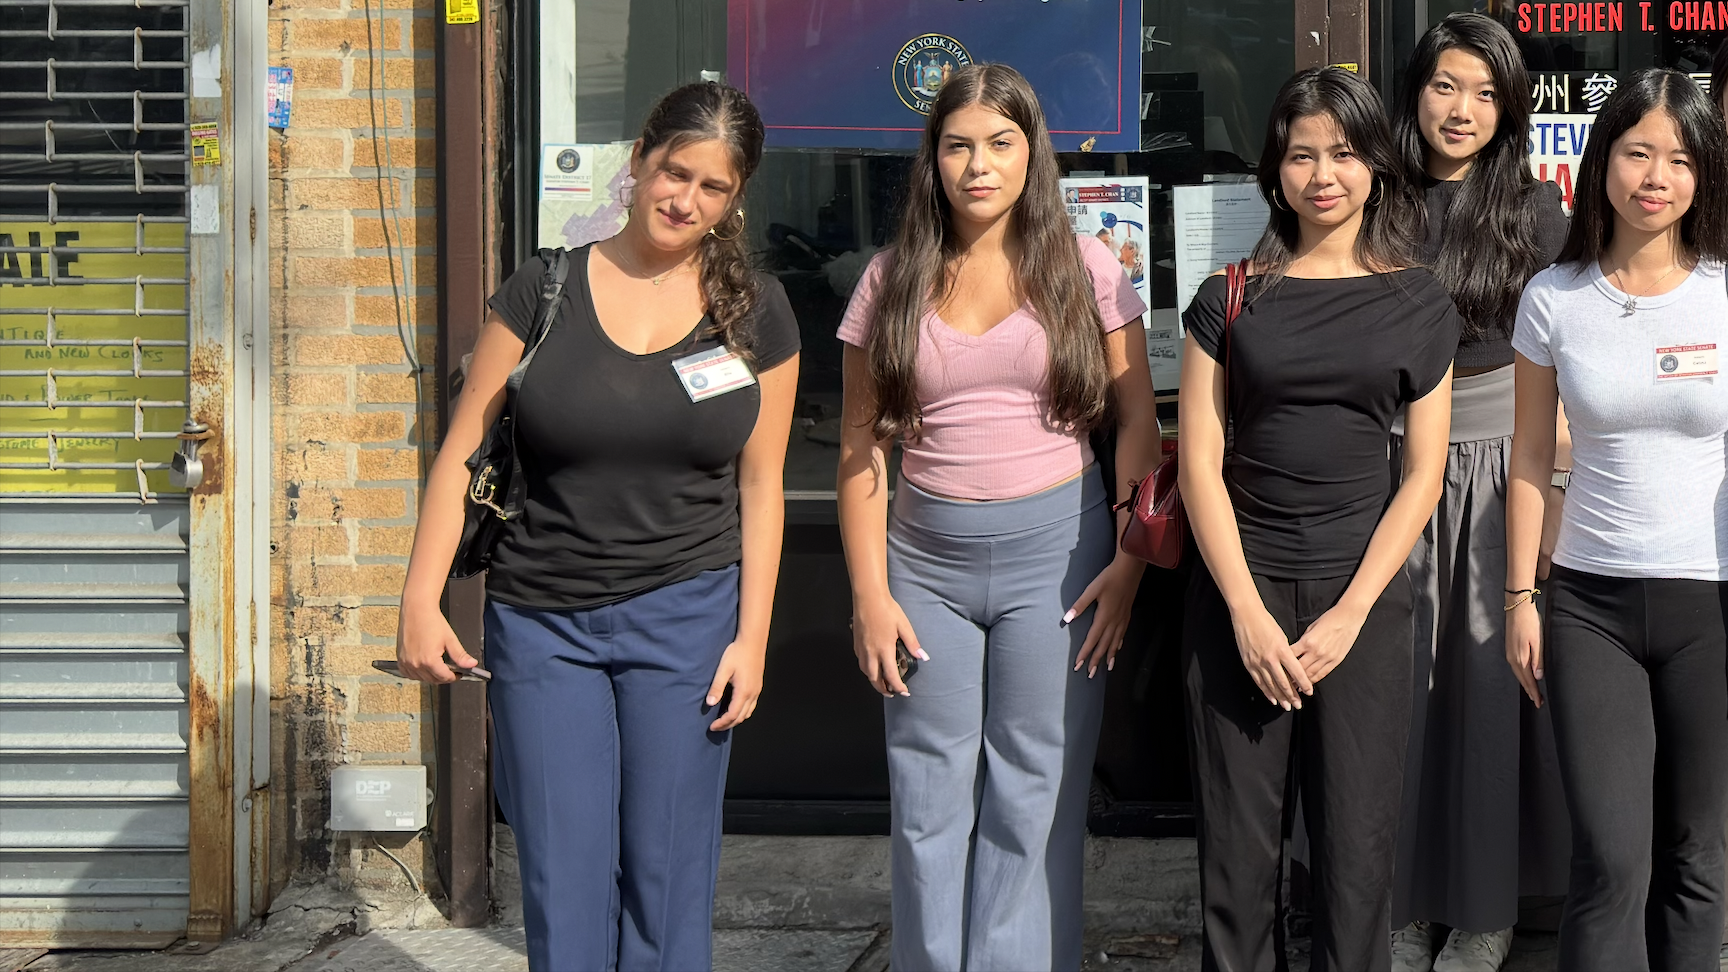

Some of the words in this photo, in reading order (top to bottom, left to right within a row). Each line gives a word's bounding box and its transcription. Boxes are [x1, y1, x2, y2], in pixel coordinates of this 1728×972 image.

[1517, 2, 1624, 33] STEPHEN
[1638, 1, 1655, 32] T.
[898, 43, 917, 65] NEW
[917, 36, 947, 48] YORK
[946, 41, 970, 68] STATE
[355, 780, 392, 795] DEP
